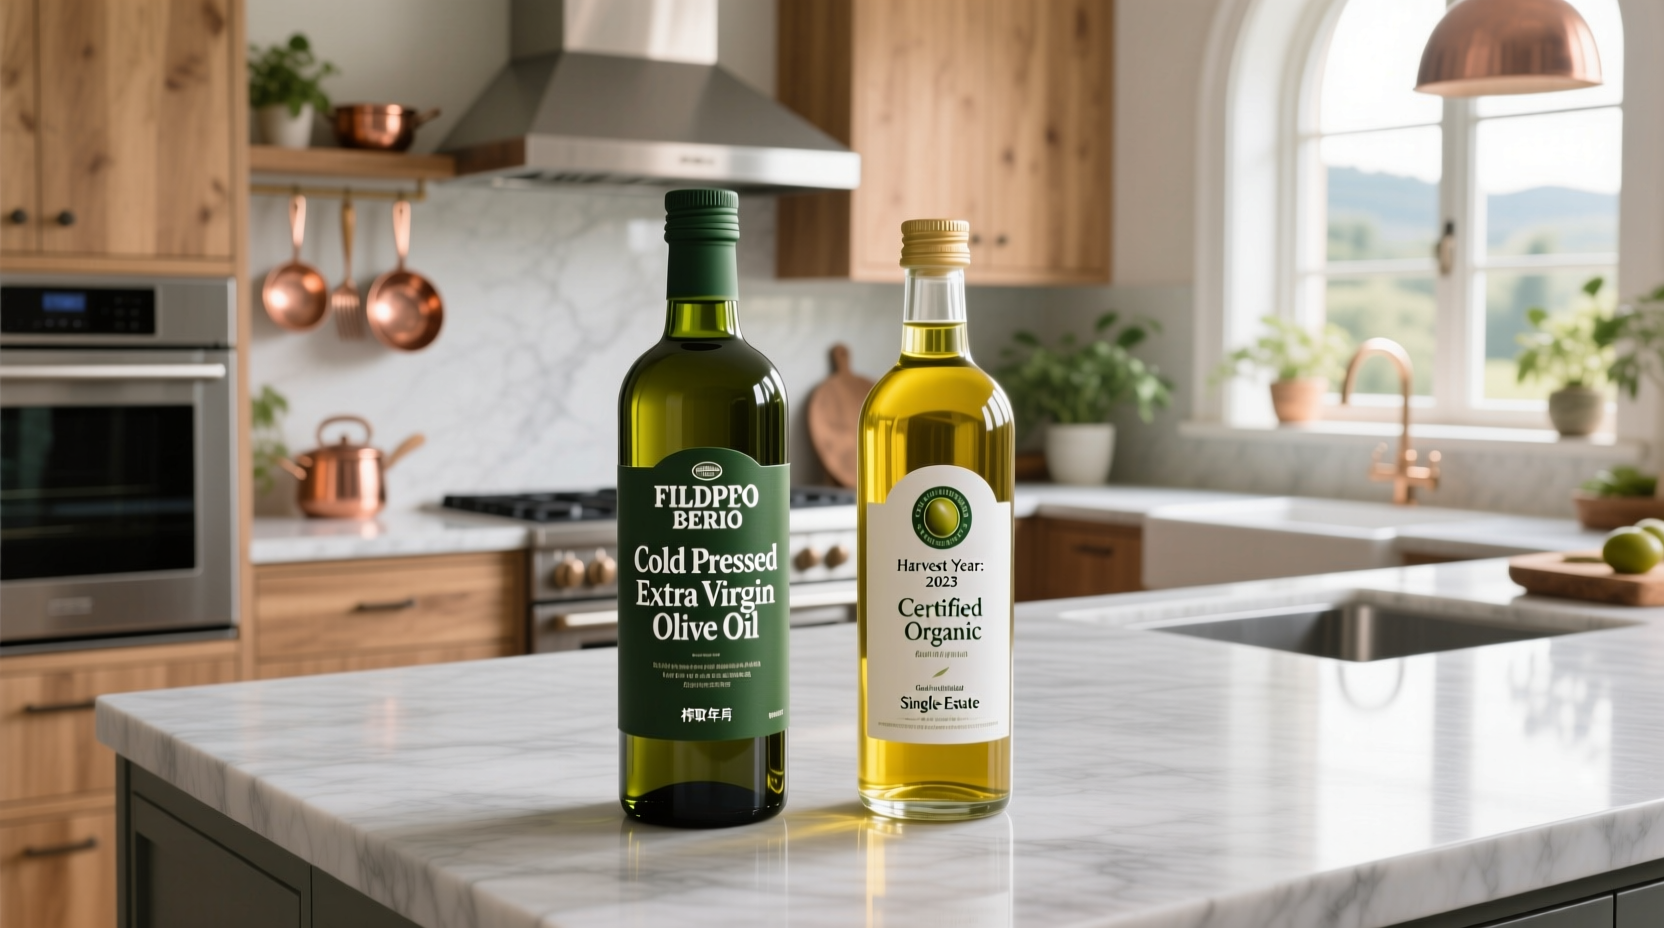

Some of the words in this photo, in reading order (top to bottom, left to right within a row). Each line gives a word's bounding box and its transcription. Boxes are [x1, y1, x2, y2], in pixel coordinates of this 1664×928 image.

[673, 510, 742, 529] BERIO
[634, 545, 687, 574] Cold
[691, 543, 778, 574] Pressed
[897, 559, 947, 572] Harvest
[951, 559, 984, 572] Year:
[926, 575, 958, 588] 2023
[636, 579, 698, 607] Extra
[702, 579, 775, 614] Virgin
[898, 597, 983, 618] Certified
[653, 612, 718, 641] Olive
[723, 610, 759, 641] Oil
[904, 621, 982, 647] Organic
